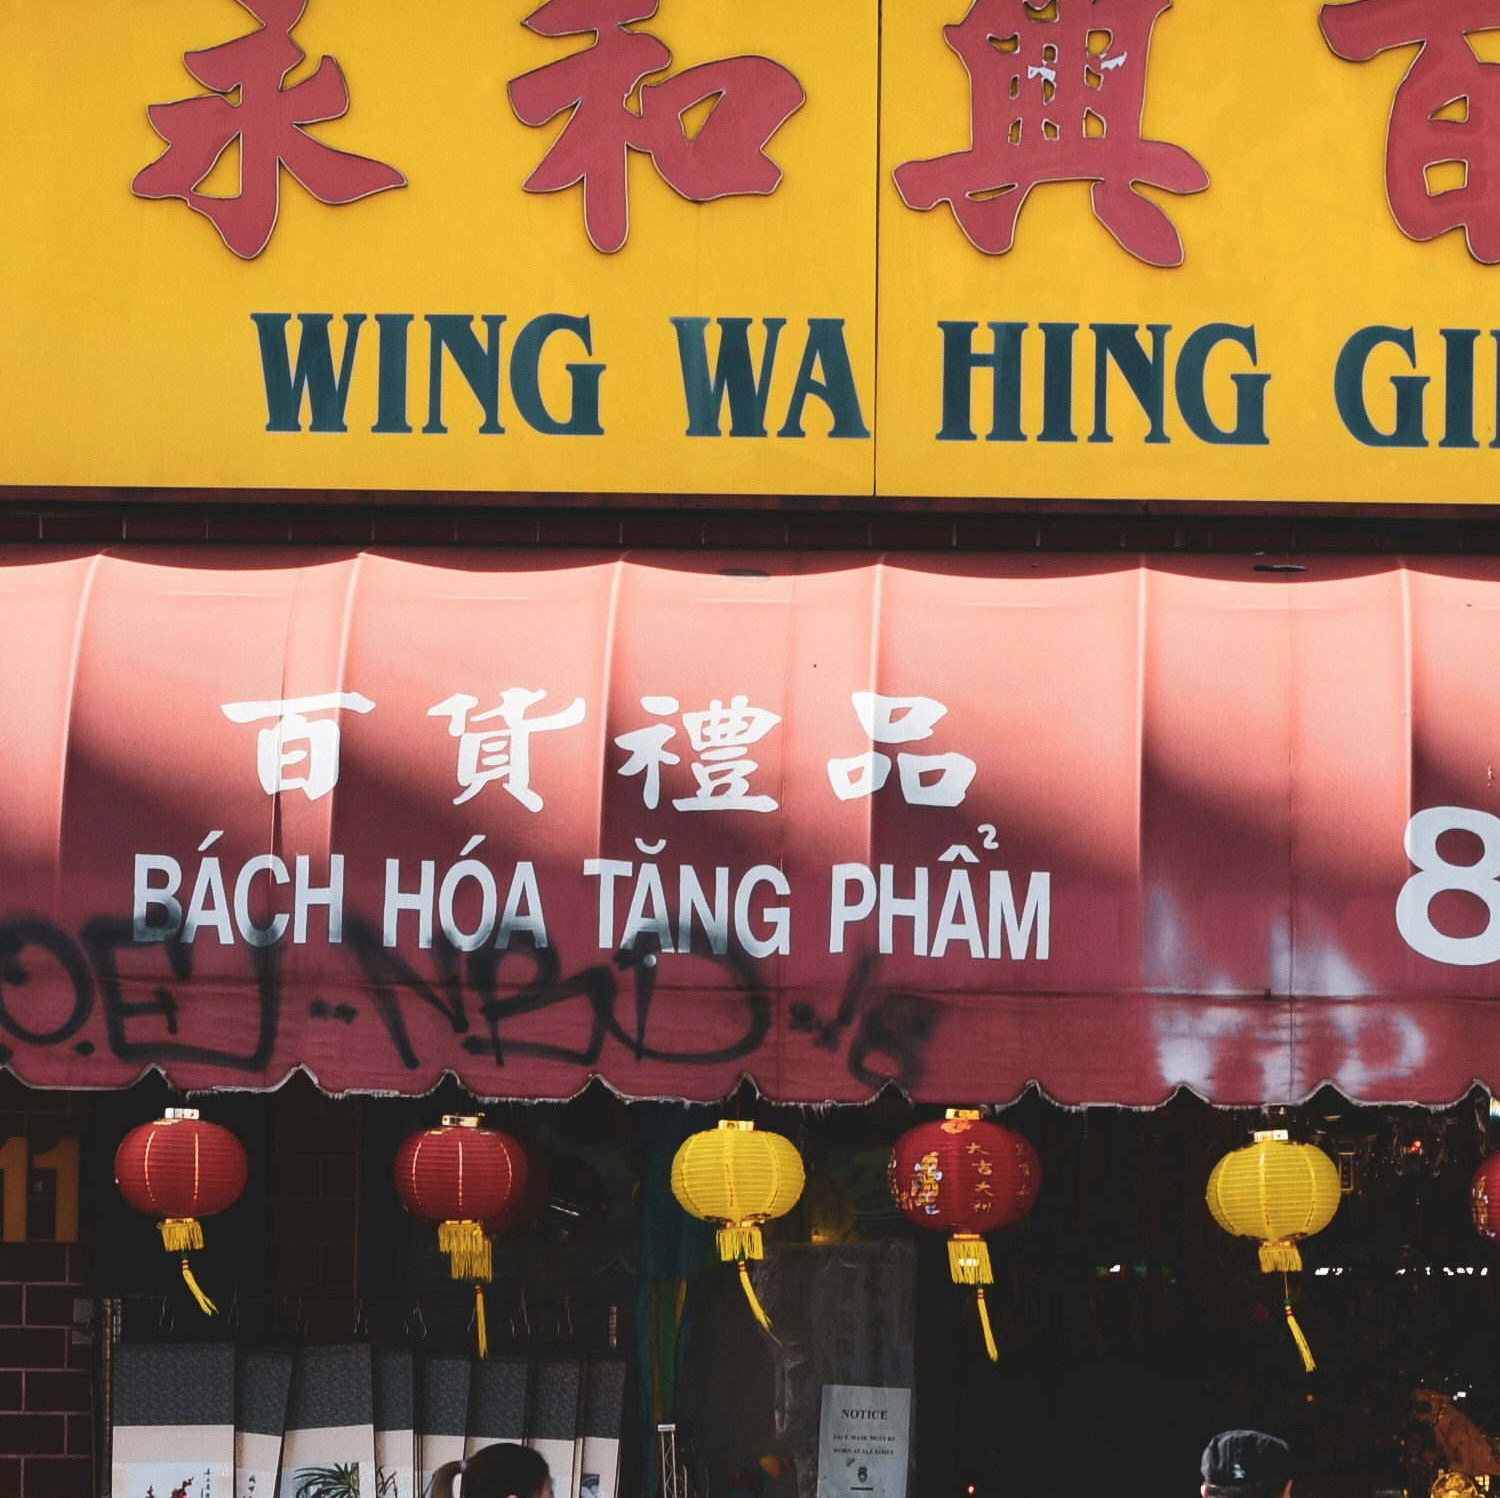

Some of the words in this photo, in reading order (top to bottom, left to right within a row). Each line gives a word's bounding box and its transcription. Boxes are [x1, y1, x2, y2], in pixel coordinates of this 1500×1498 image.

[250, 312, 606, 437] WING
[670, 316, 871, 439] WA
[935, 320, 1271, 445] HING
[221, 687, 977, 813] 百貨禮品
[133, 829, 344, 945] BÁCH
[383, 834, 548, 952] HÓA
[841, 1409, 888, 1420] NOTICE
